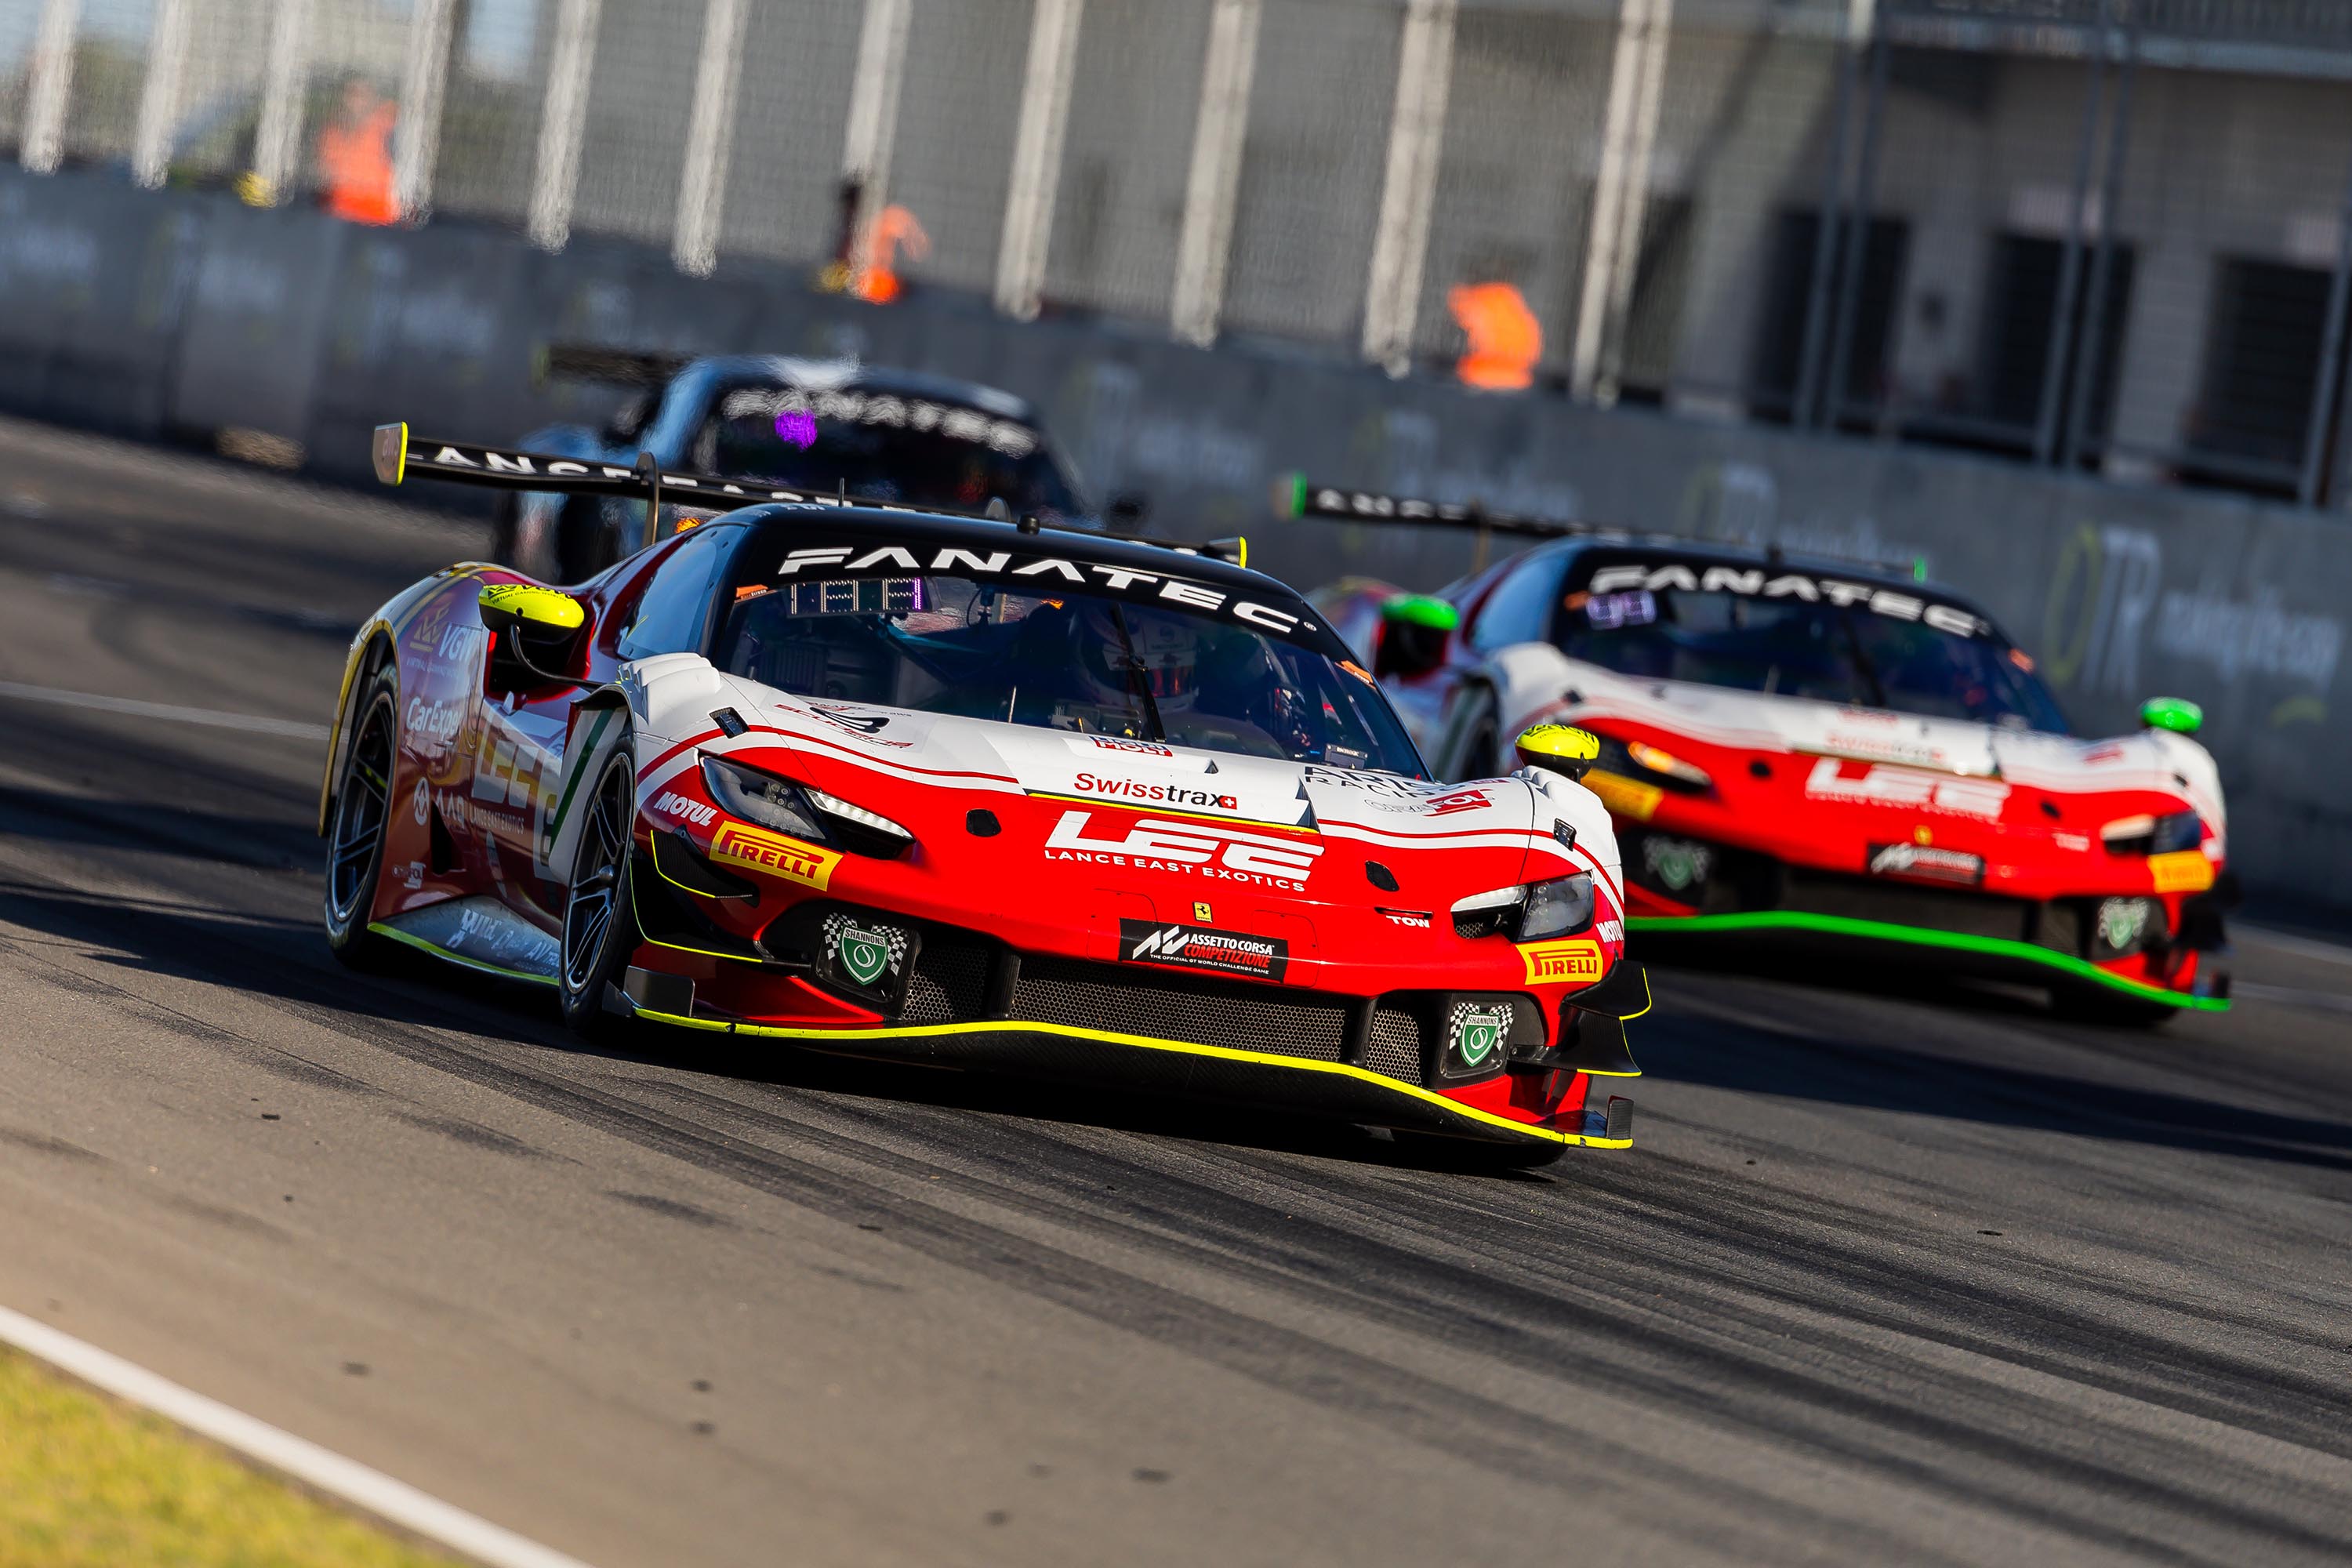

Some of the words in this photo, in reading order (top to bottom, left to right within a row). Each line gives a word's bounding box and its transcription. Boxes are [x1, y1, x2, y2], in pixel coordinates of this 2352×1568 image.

[778, 546, 1300, 633] FANATEC
[1590, 564, 1979, 637] FANATEC
[1096, 740, 1168, 756] MOLY
[1074, 773, 1224, 808] Swisstrax
[653, 791, 718, 827] MOTUL
[718, 829, 825, 880] PIRELLI
[1044, 810, 1325, 882] LEE
[1044, 849, 1127, 866] LANCE
[1134, 858, 1195, 875] EAST
[1202, 867, 1305, 892] EXOTICS
[1385, 915, 1431, 928] TOW
[1595, 920, 1624, 943] MOTU
[844, 928, 885, 946] SHANNONS
[1189, 933, 1238, 949] ASSETTO
[1237, 939, 1273, 956] CORSA
[1184, 943, 1272, 968] COMPETIZIONE
[1219, 963, 1253, 972] CHALLENGE
[1527, 948, 1596, 977] PIRELLI
[1467, 1015, 1498, 1025] SHANNONS
